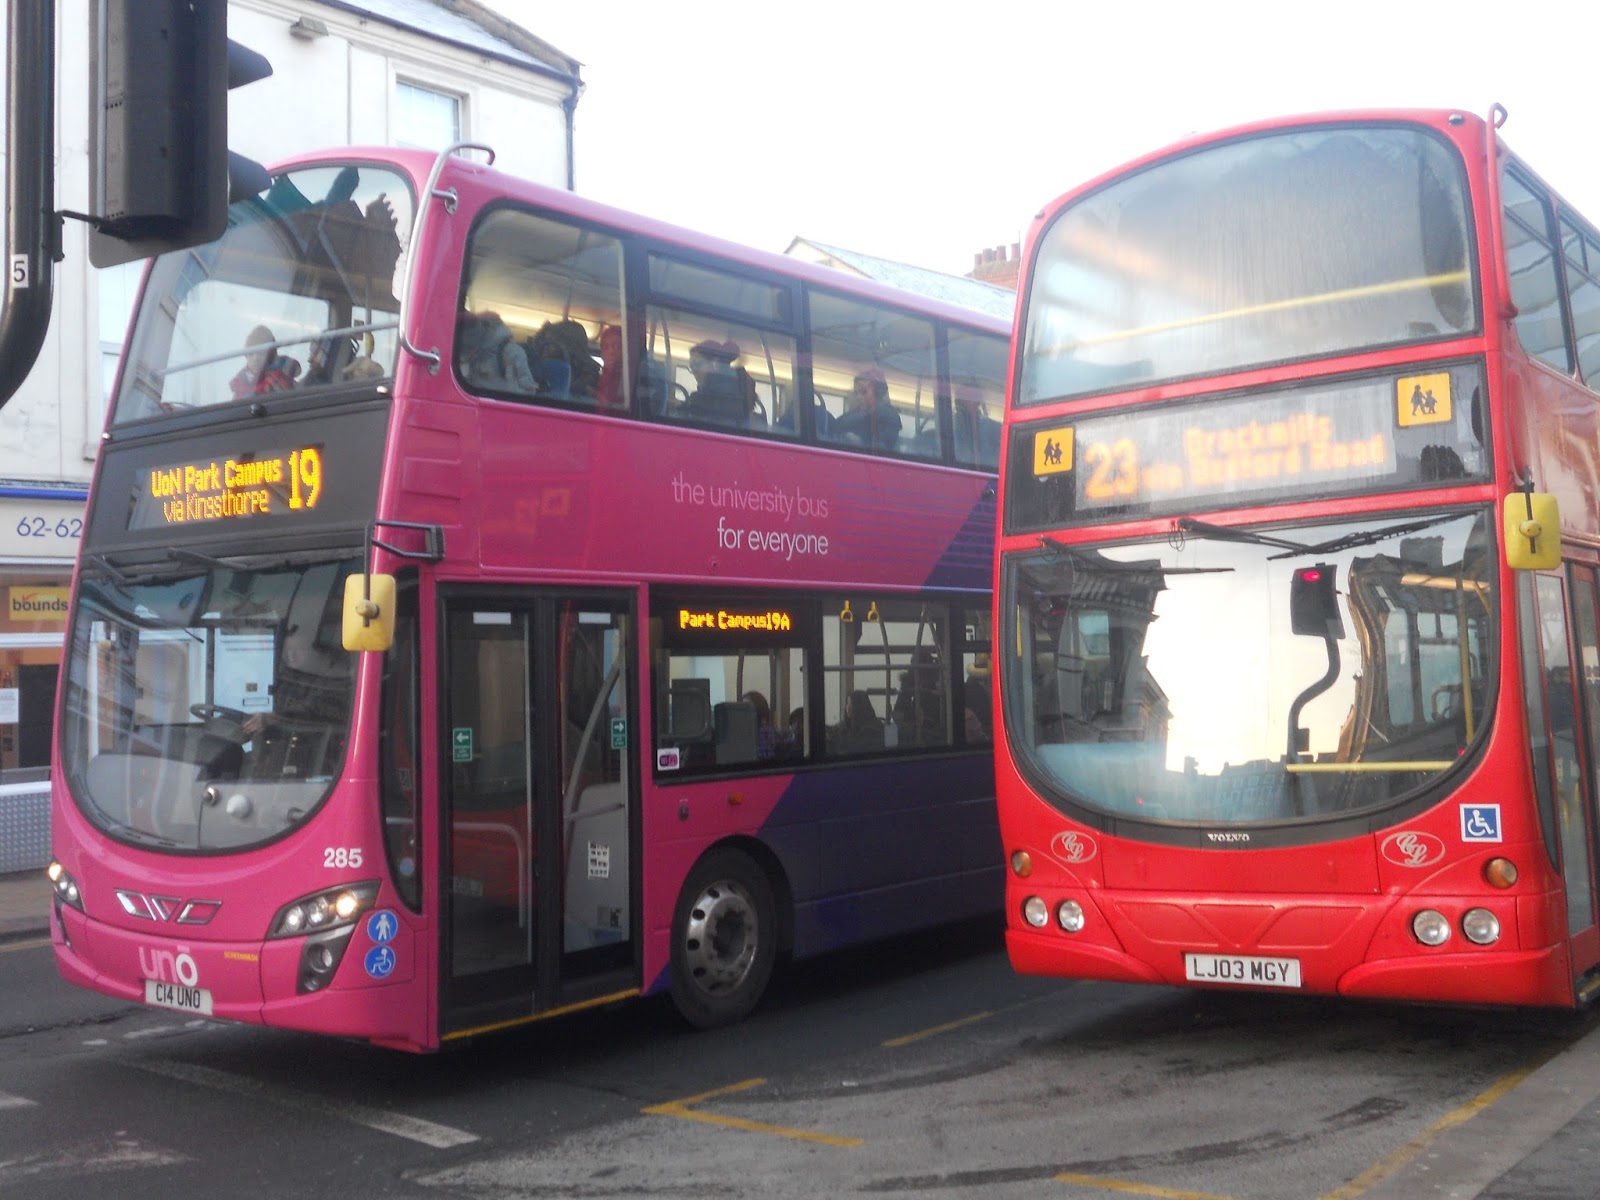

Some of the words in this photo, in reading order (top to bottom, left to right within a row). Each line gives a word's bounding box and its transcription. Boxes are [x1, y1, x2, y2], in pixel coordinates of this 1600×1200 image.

[13, 260, 26, 282] 5
[184, 462, 220, 493] Park
[224, 457, 282, 488] Campus
[288, 447, 322, 510] 19
[1083, 437, 1138, 499] 23
[671, 471, 706, 505] the
[710, 481, 794, 522] university
[797, 486, 829, 518] bus
[717, 516, 745, 549] for
[748, 530, 829, 561] everyone
[12, 597, 69, 613] bounds
[679, 610, 715, 630] Park
[1207, 833, 1250, 842] VOLVO
[323, 847, 363, 869] 285
[1193, 955, 1246, 980] LJ03
[1249, 959, 1290, 984] MGY
[177, 987, 201, 1009] UNO
